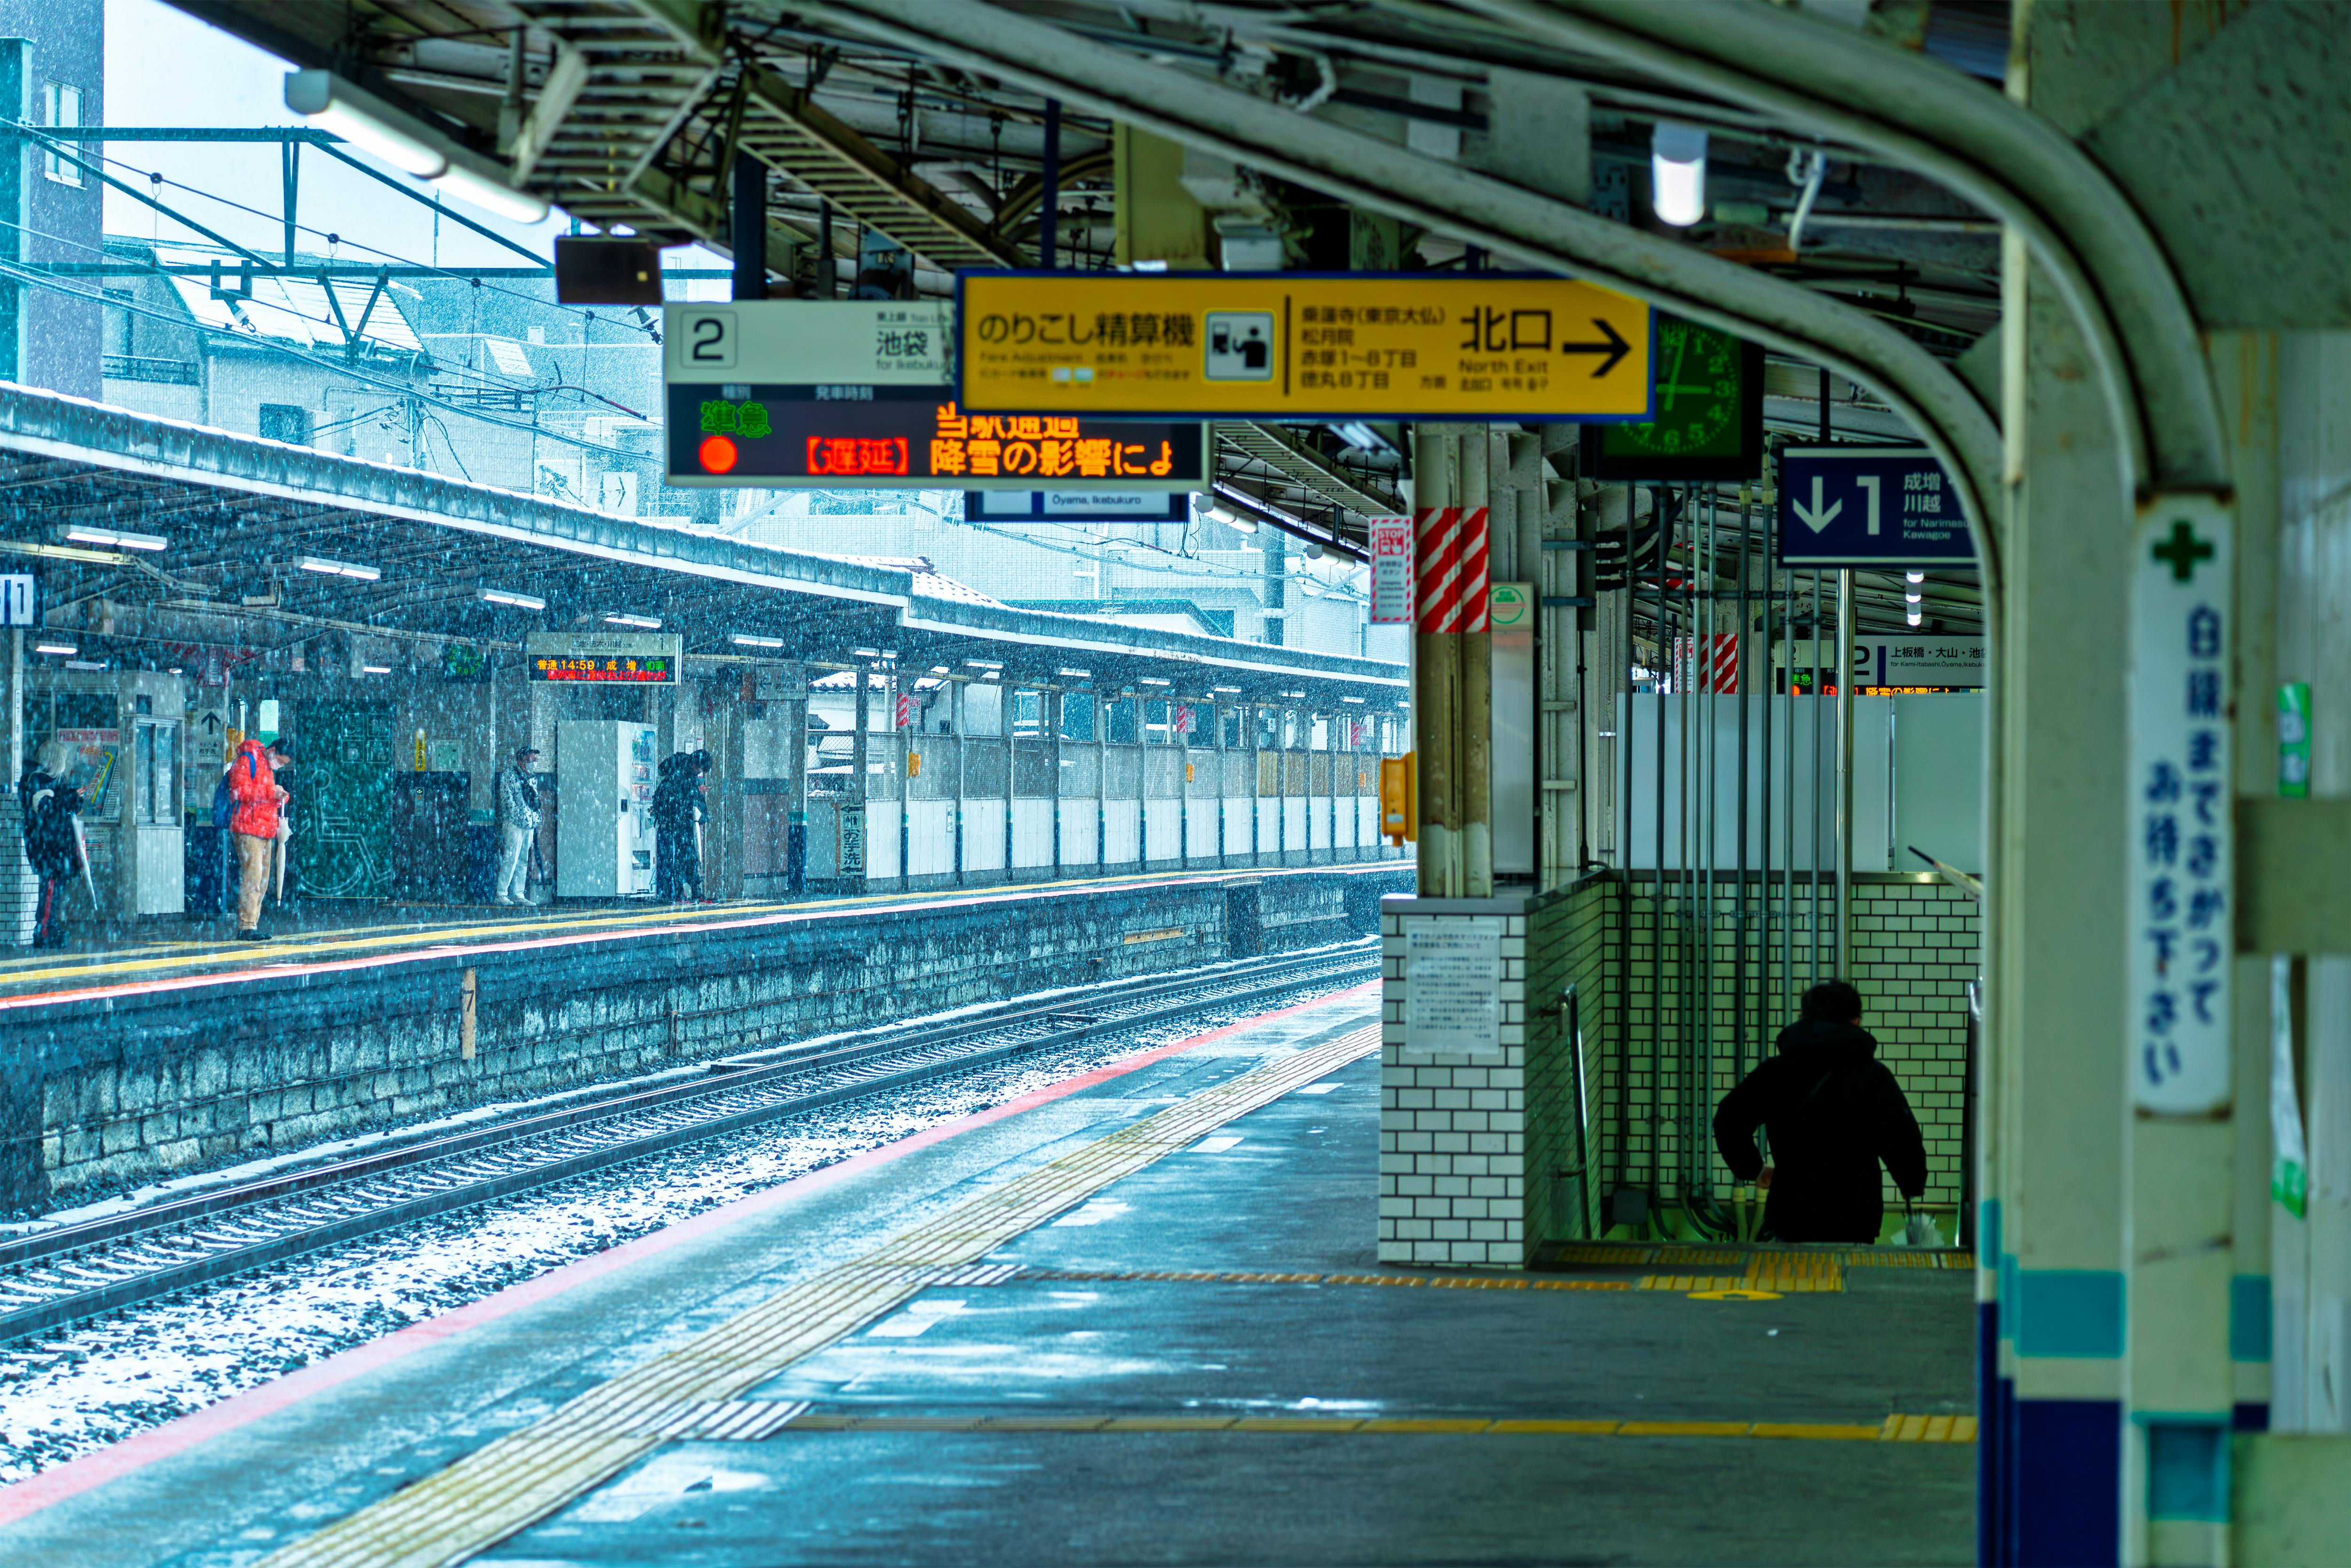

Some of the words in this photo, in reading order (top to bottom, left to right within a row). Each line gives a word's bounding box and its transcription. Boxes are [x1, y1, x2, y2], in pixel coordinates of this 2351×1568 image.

[978, 312, 1195, 348] のりこし精算機
[1460, 305, 1551, 353] 北口
[693, 317, 724, 361] 2
[876, 330, 928, 356] 池袋
[1694, 337, 1704, 355] 1
[876, 359, 891, 370] for
[896, 359, 942, 370] Ikebuku
[1460, 360, 1508, 374] North
[1514, 360, 1549, 374] Exit
[1708, 356, 1725, 374] 2
[1715, 379, 1731, 398] 3
[700, 400, 772, 438] 準急
[1706, 404, 1722, 420] 4
[1639, 422, 1655, 441] 7
[1664, 429, 1680, 447] 6
[1688, 423, 1704, 441] 5
[1903, 472, 1941, 491] 成増
[1092, 495, 1142, 505] Ikebukuro
[1856, 475, 1880, 536] 1
[1903, 494, 1941, 513] 川越
[1903, 518, 1918, 528] for
[1378, 530, 1404, 539] STOP
[1903, 529, 1951, 541] Kawagoe
[17, 583, 24, 614] 1
[659, 638, 664, 650] 1
[537, 659, 558, 670] 普通
[560, 660, 595, 670] 14:59
[646, 660, 665, 670] 10両
[1854, 645, 1870, 676] 2
[843, 829, 861, 866] お手洗
[463, 990, 475, 1013] 7
